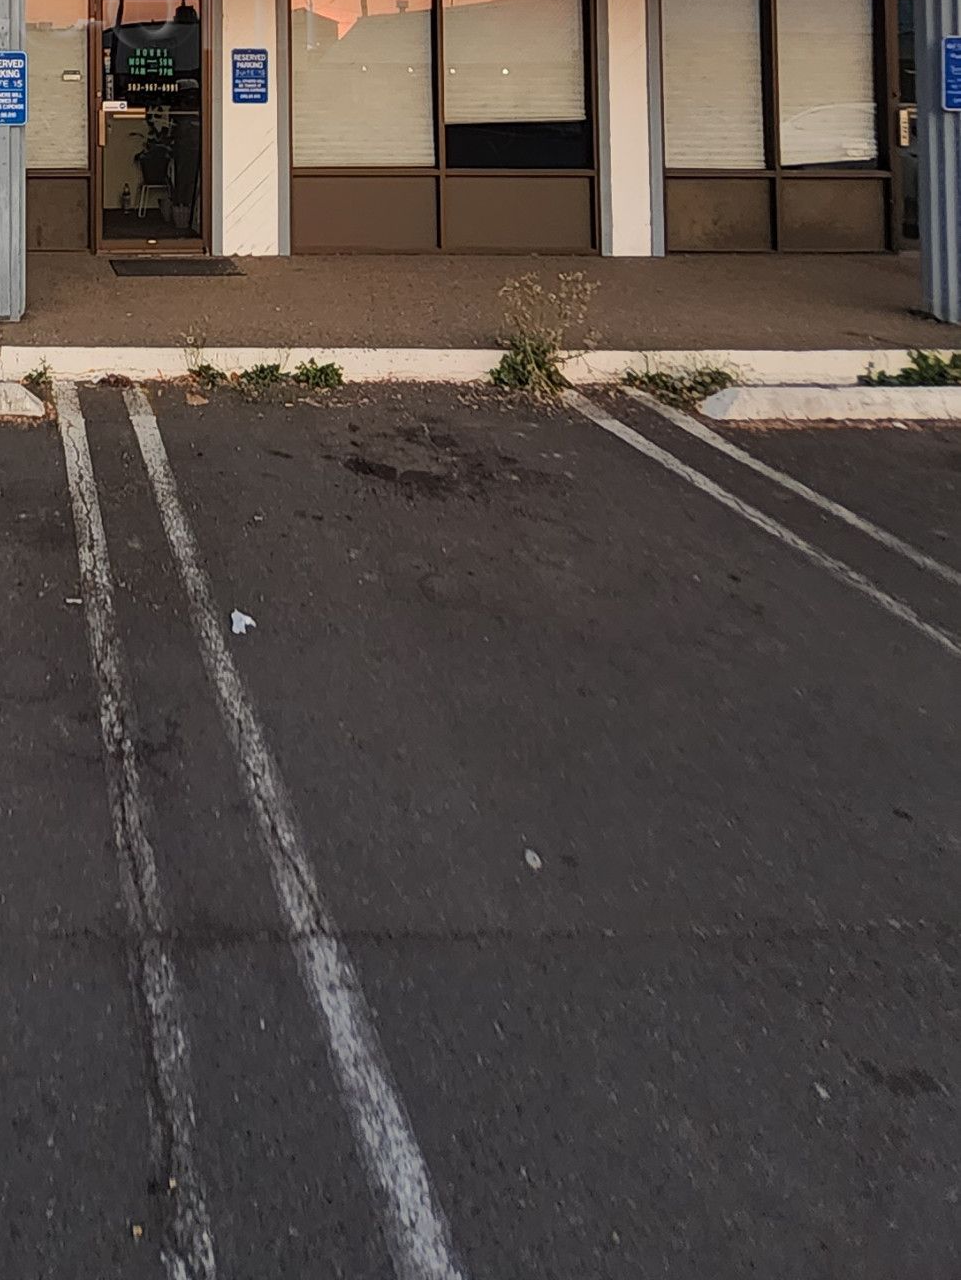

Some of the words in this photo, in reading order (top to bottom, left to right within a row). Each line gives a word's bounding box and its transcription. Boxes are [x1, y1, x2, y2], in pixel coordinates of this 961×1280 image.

[136, 48, 167, 57] HOURS
[237, 61, 264, 69] PARKING
[13, 79, 23, 88] 15
